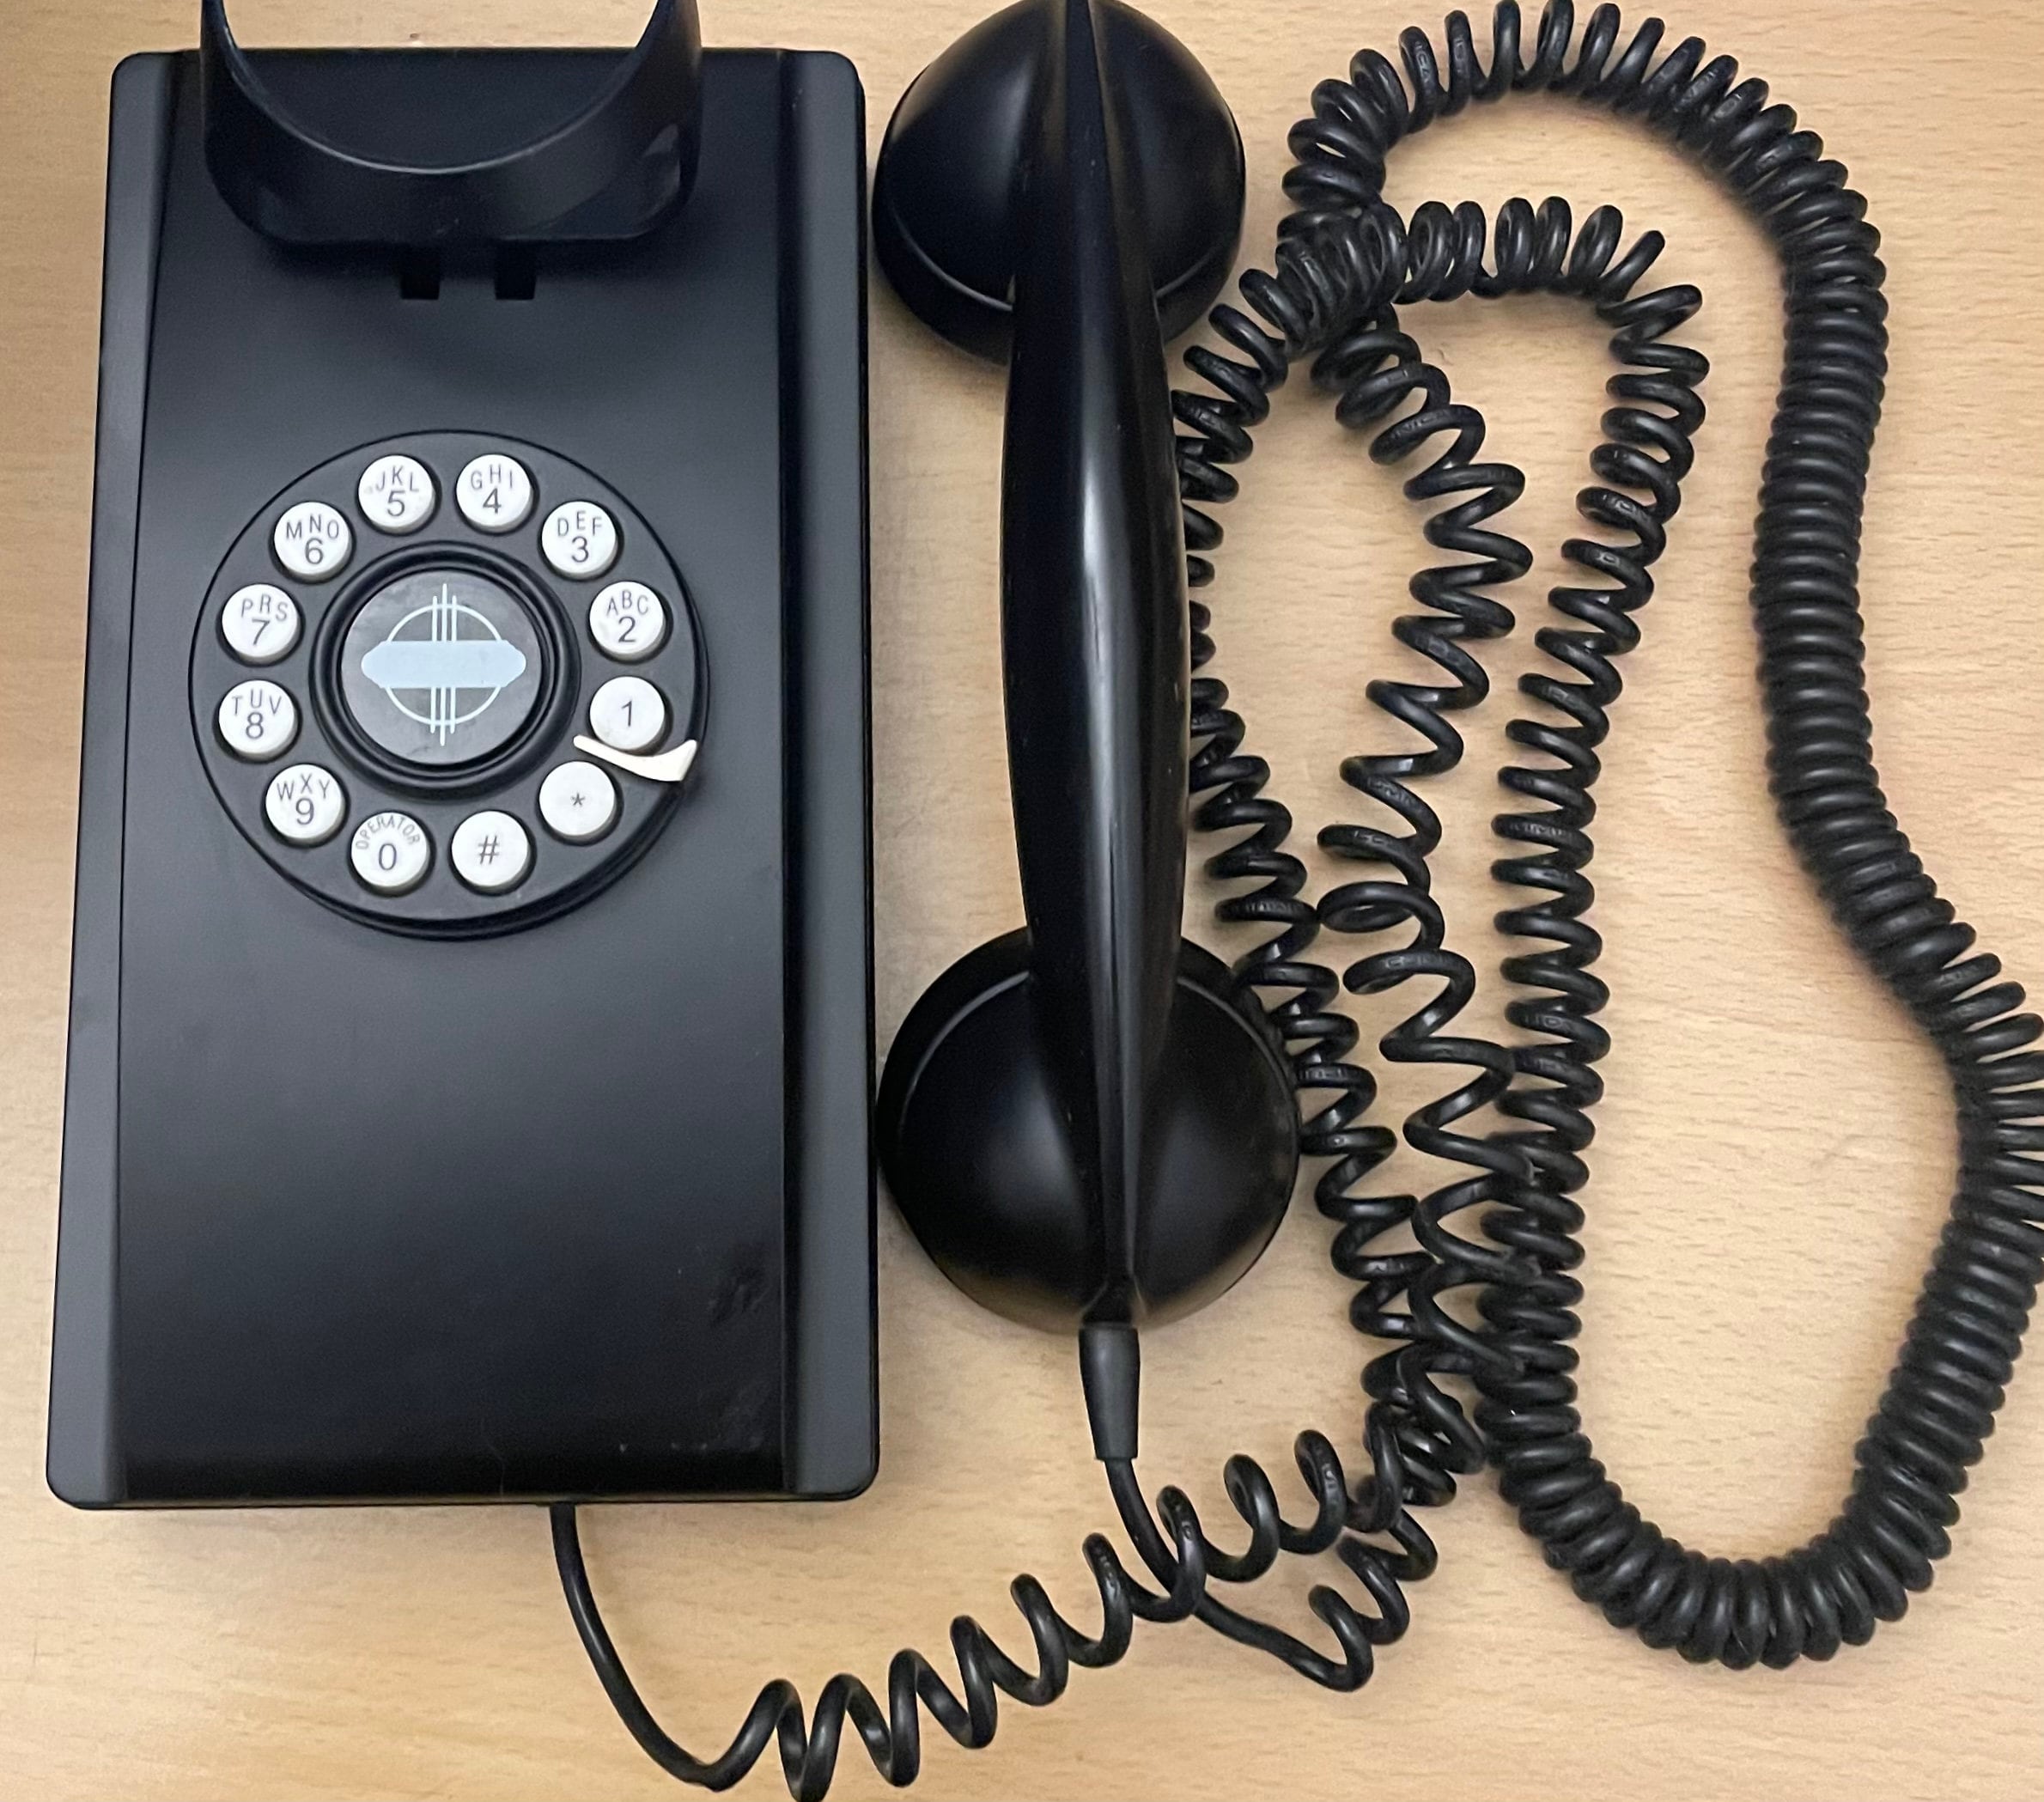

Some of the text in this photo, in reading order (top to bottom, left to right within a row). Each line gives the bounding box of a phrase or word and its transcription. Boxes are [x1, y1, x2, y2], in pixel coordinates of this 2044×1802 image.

[376, 465, 420, 493] JKL
[470, 464, 513, 490] GHI
[386, 490, 405, 517] 5
[482, 487, 502, 514] 4
[285, 514, 340, 540] MNO
[557, 509, 604, 537] DEF
[305, 537, 325, 565] 6
[571, 536, 589, 563] 3
[240, 594, 289, 622] PRS
[606, 588, 650, 616] ABC
[252, 618, 271, 646] 7
[618, 616, 636, 642] 2
[231, 688, 283, 716] TUV
[621, 700, 633, 727] 1
[246, 712, 264, 740] 8
[276, 773, 332, 801] WXY
[295, 798, 314, 825] 9
[355, 813, 421, 850] OPERATOR
[379, 843, 397, 871] 0
[478, 835, 499, 865] #
